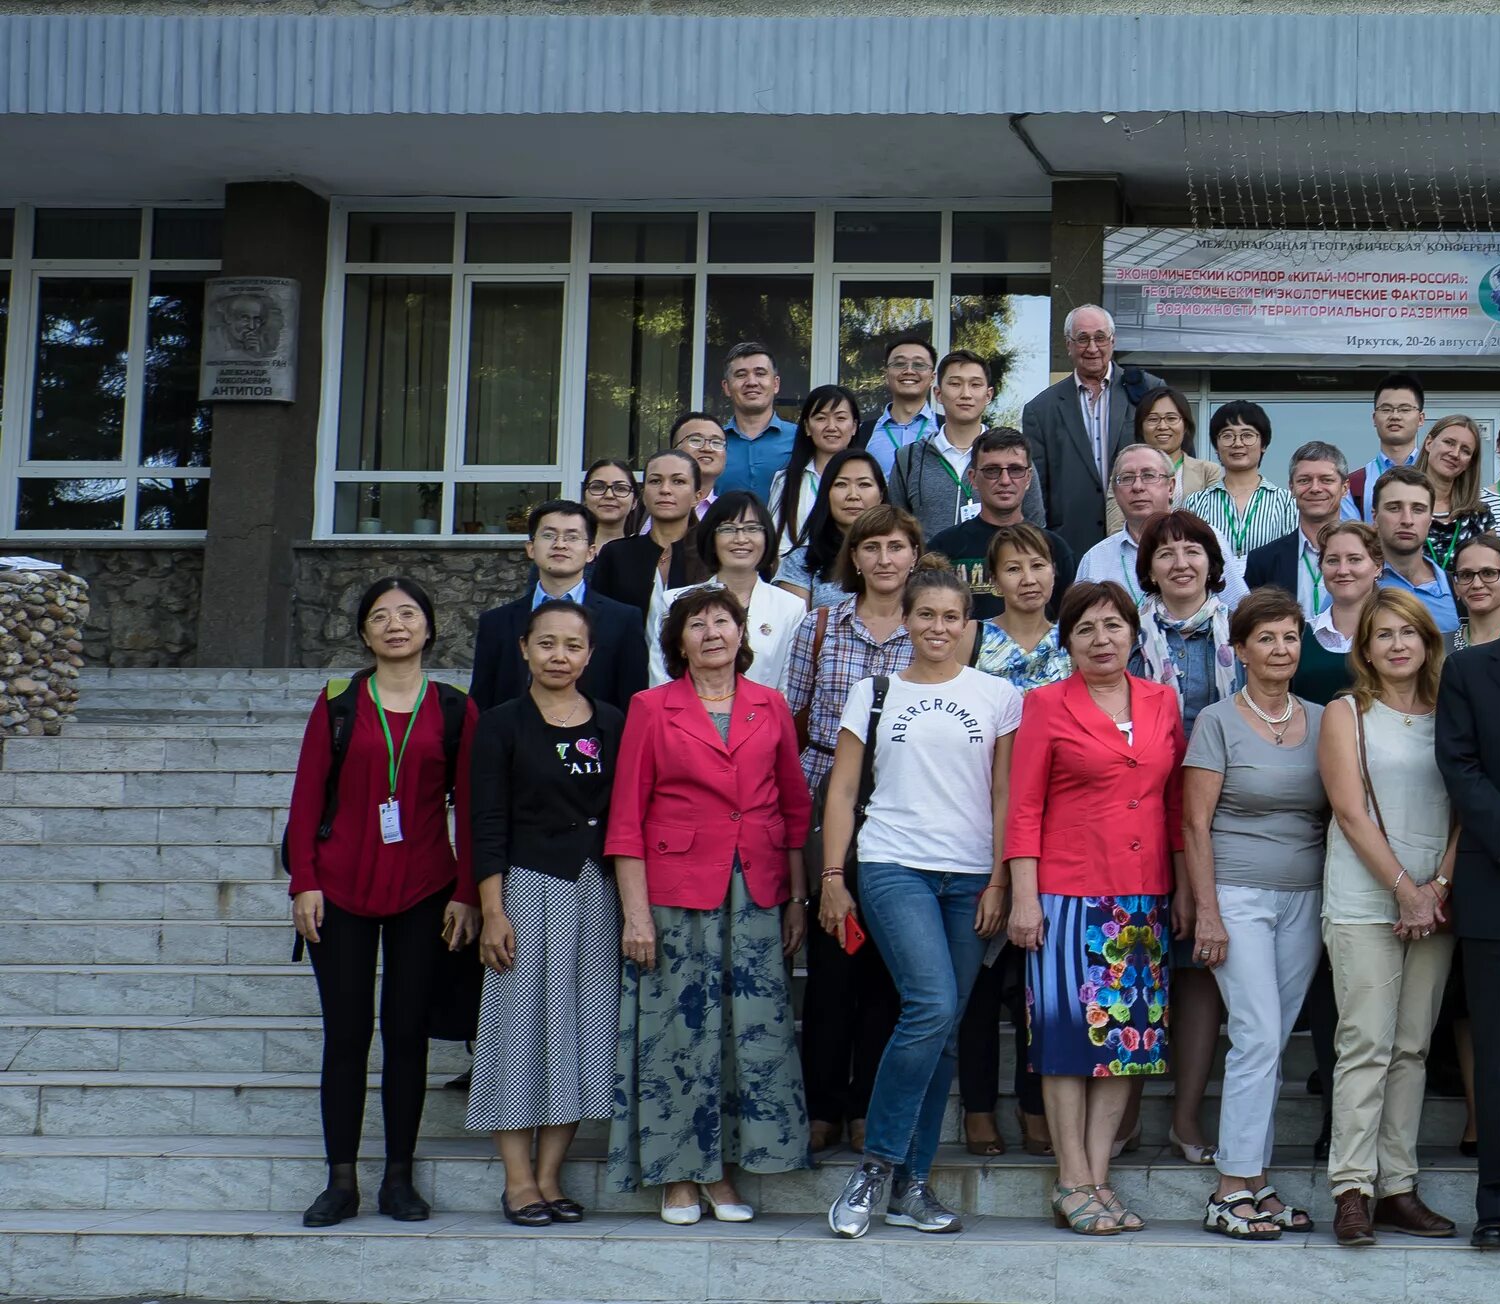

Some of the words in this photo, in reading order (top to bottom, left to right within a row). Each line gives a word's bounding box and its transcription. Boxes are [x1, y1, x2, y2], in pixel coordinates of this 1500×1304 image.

[1196, 239, 1307, 250] МЕЖДУНАРОДНАЯ
[1312, 241, 1421, 251] ГЕОГРАФИЧЕСКАЯ
[1116, 268, 1224, 281] ЭКОНОМИЧЕСКИЙ
[1226, 271, 1285, 282] КОРИДОР
[1142, 286, 1261, 298] ГЕОГРАФИЧЕСКИЕ
[1264, 288, 1274, 299] И
[1276, 288, 1387, 300] ЭКОЛОГИЧЕСКИЕ
[1391, 289, 1456, 300] ФАКТОРЫ
[1459, 290, 1468, 301] И
[1156, 303, 1257, 316] ВОЗМОЖНОСТИ
[1260, 304, 1398, 318] ТЕРРИТОРИАЛЬНОГО
[1400, 306, 1469, 319] РАЗВИТИЯ
[1346, 335, 1403, 348] Иркутск,
[1406, 336, 1437, 347] 20-26
[1439, 338, 1488, 349] августа,
[211, 386, 273, 396] АНТИПОВ
[891, 698, 984, 744] ABERCROMBIE
[564, 762, 601, 774] ALI
